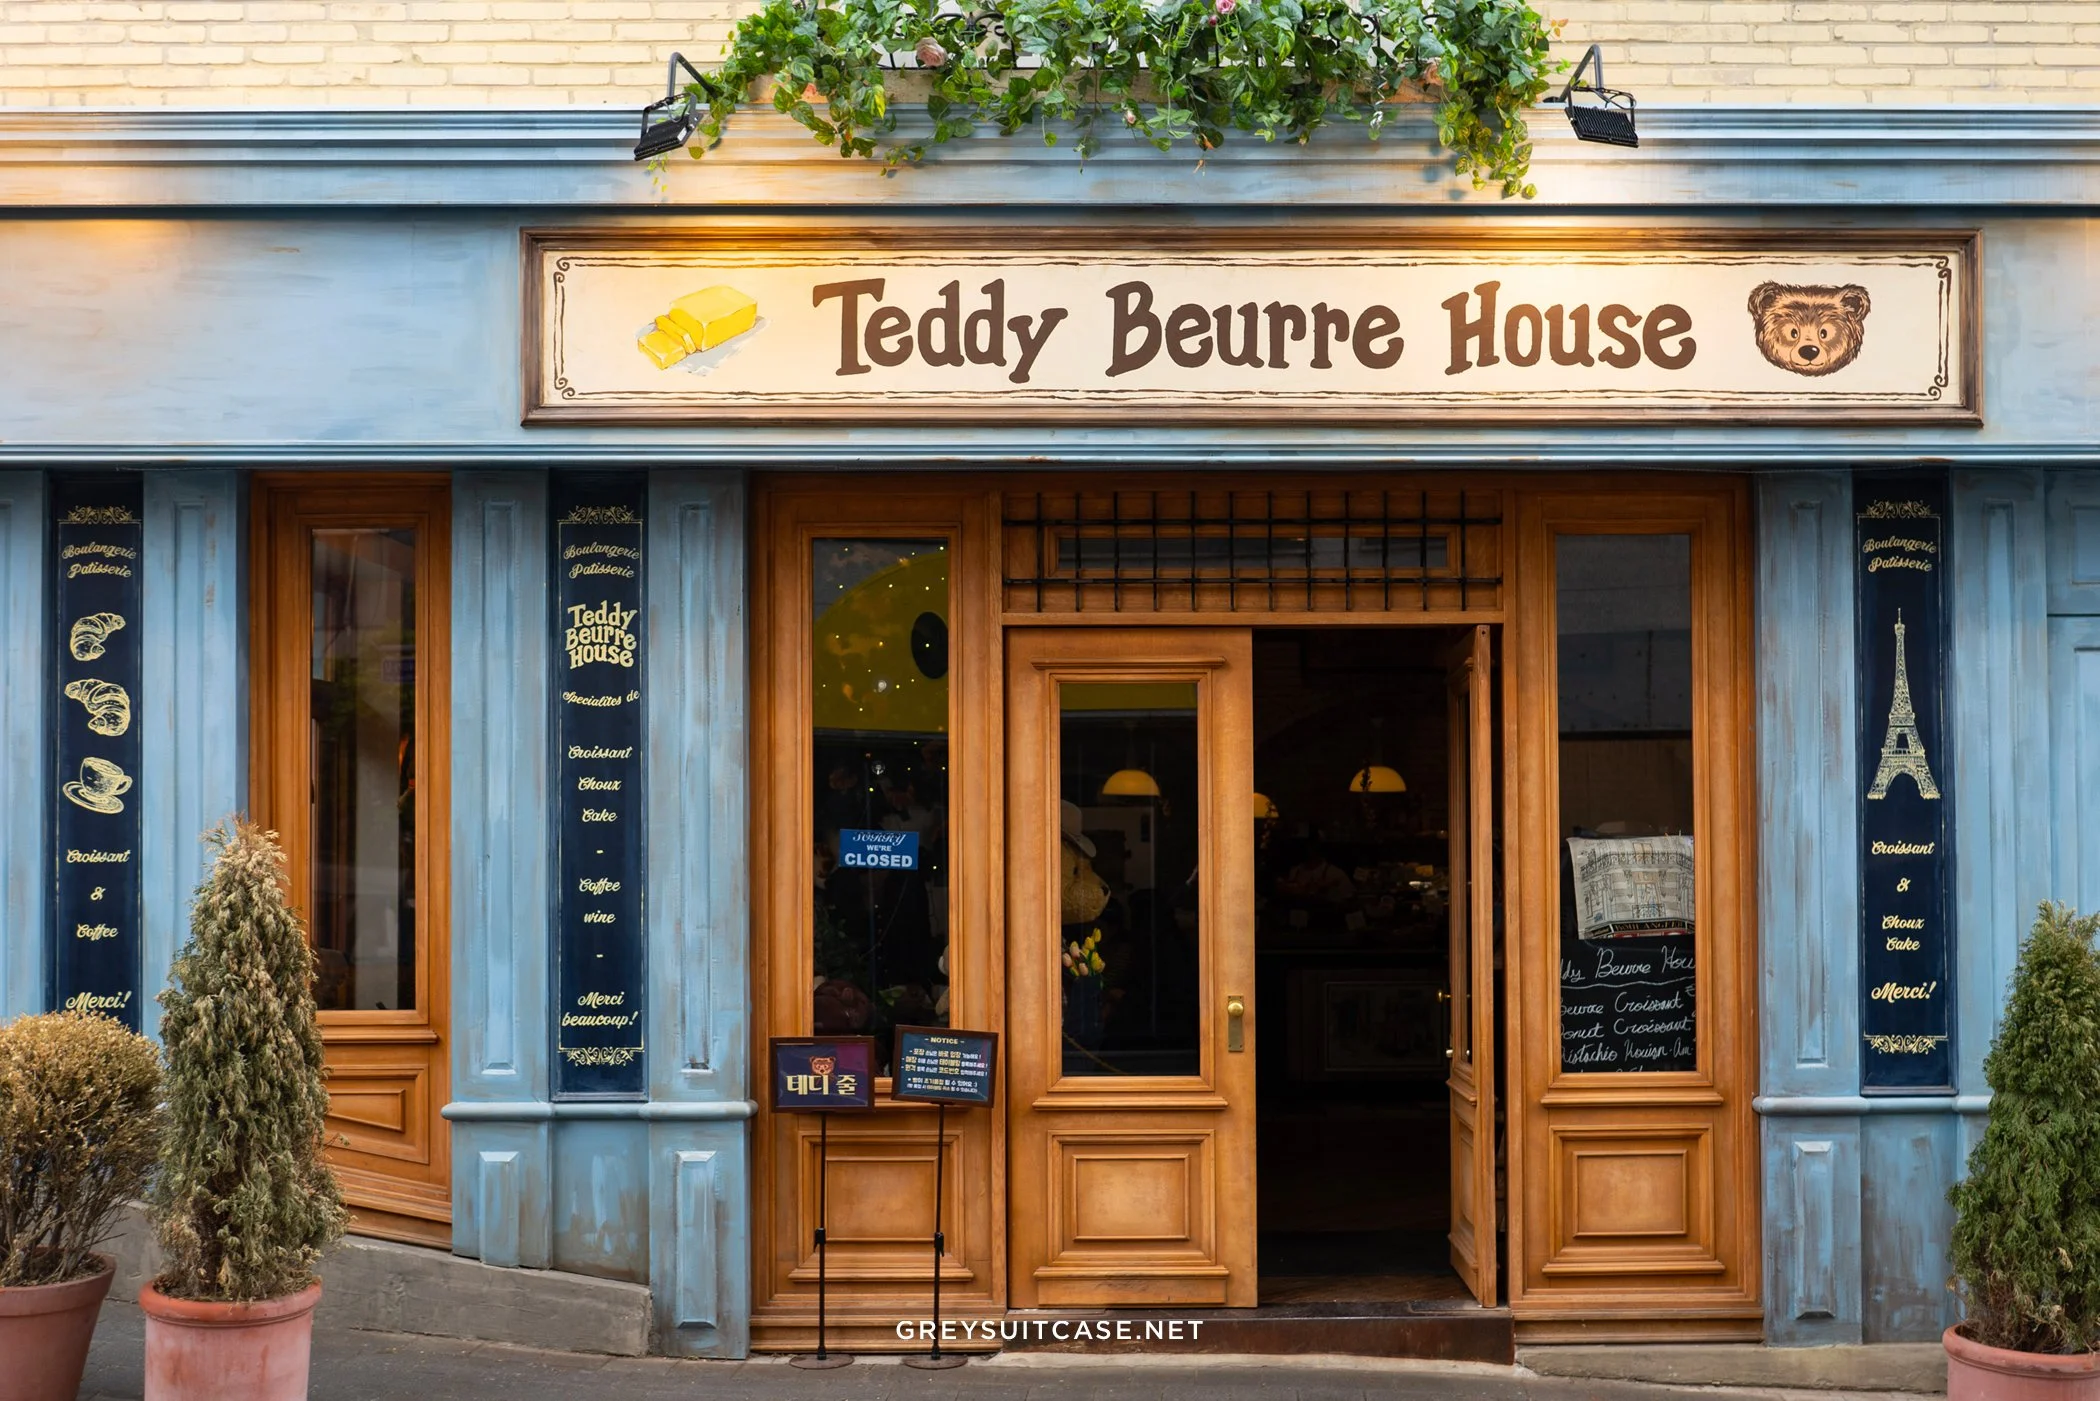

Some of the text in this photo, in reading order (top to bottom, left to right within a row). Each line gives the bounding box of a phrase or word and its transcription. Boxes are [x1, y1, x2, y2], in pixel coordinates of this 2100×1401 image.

[812, 277, 1697, 383] Teddy Beurre House
[61, 541, 137, 559] Boulangerie
[563, 542, 640, 560] Boulangerie
[1862, 535, 1937, 554] Boulangerie
[67, 561, 132, 579] Patisserie
[568, 562, 635, 579] Patisserie
[1867, 555, 1933, 573] Patisserie
[567, 600, 638, 630] Teddy
[565, 625, 637, 651] Beurre
[626, 689, 640, 703] de
[568, 745, 633, 759] Croissant
[578, 776, 622, 791] Choux
[582, 808, 617, 822] Cake
[66, 849, 131, 863] Croissant
[866, 844, 892, 852] WE'RE
[1871, 840, 1935, 855] Croissant
[844, 853, 913, 867] CLOSED
[90, 886, 106, 900] &
[578, 878, 621, 893] Coffee
[1896, 878, 1911, 892] &
[584, 910, 616, 924] wine
[1882, 915, 1925, 929] Choux
[76, 923, 118, 941] Coffee
[1886, 936, 1921, 951] Cake
[1560, 959, 1586, 982] dy
[1595, 947, 1651, 978] Beurre
[578, 991, 624, 1009] Merci
[1871, 981, 1937, 1003] Merci!
[65, 990, 132, 1012] Merci!
[1614, 991, 1684, 1014] Croissant
[562, 1010, 638, 1027] beaucoup!
[1613, 1016, 1694, 1035] Croissant
[786, 1074, 829, 1095] 테디
